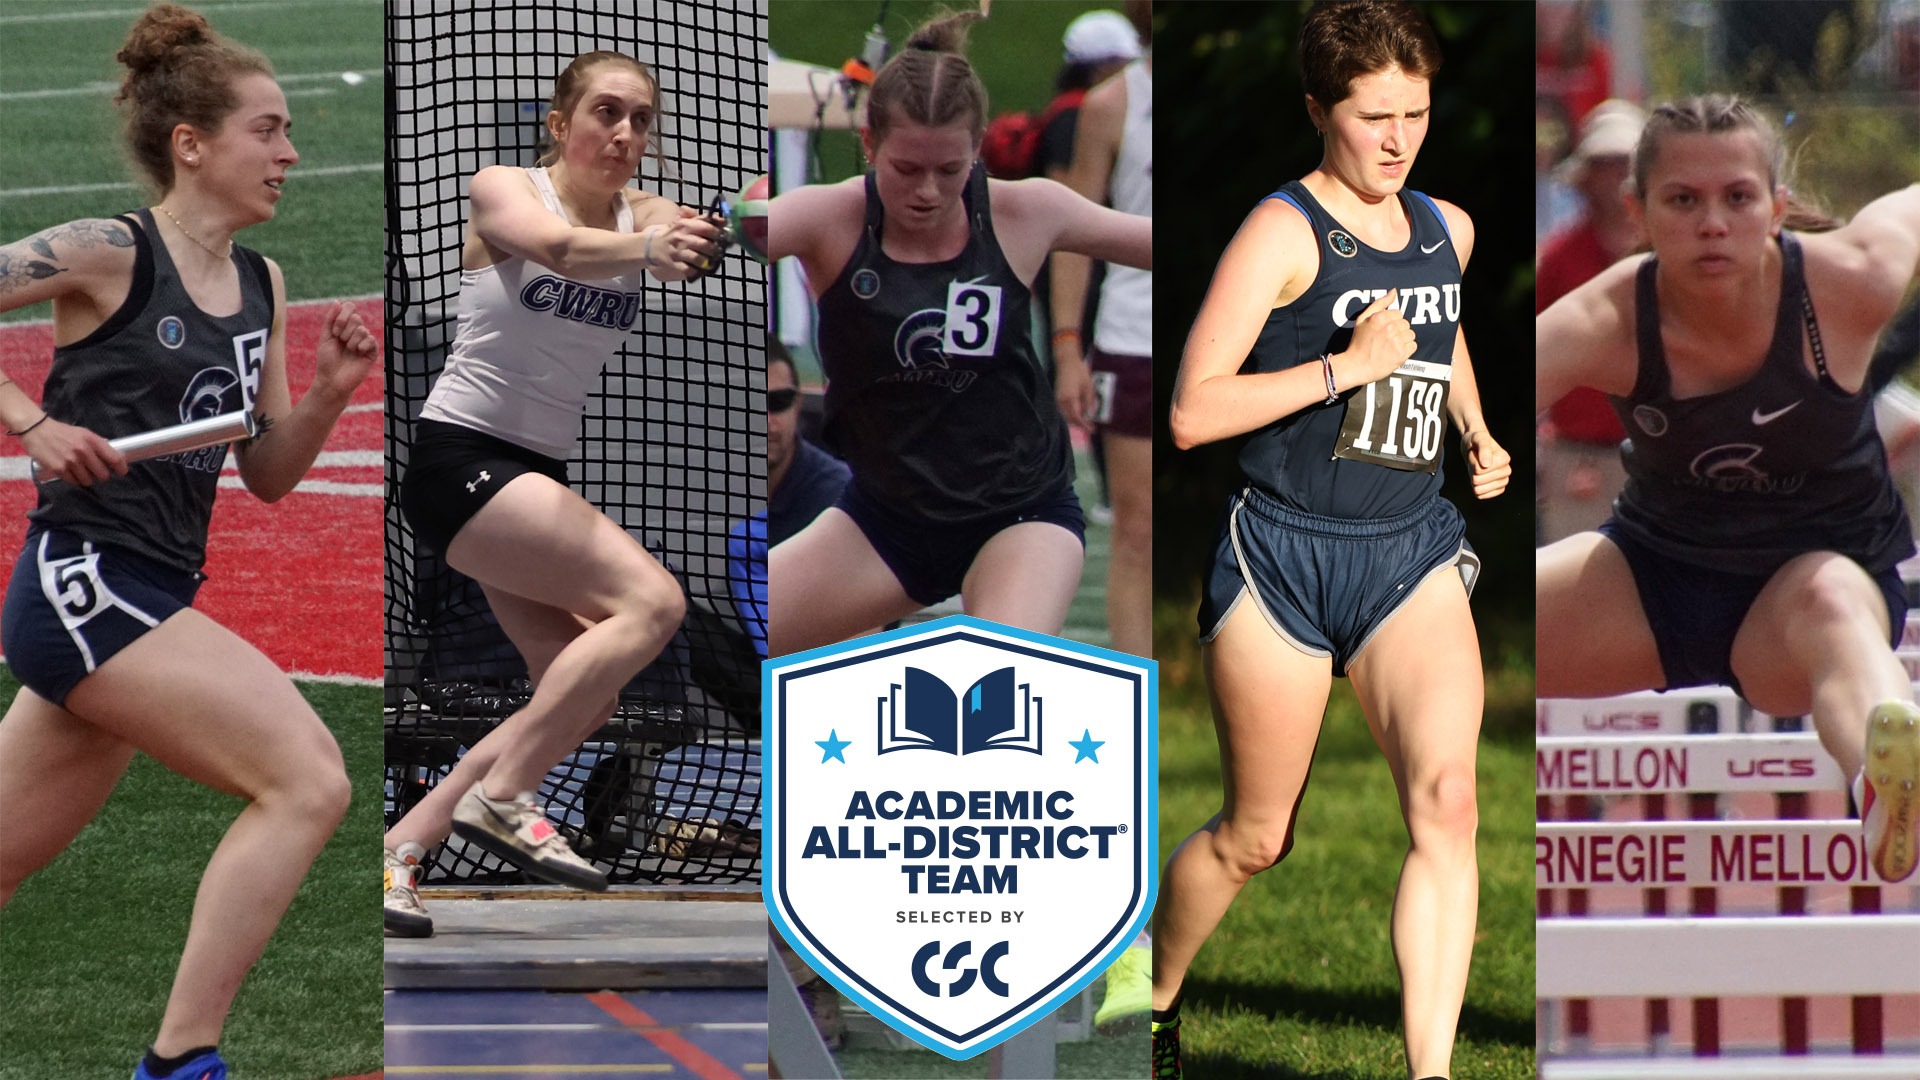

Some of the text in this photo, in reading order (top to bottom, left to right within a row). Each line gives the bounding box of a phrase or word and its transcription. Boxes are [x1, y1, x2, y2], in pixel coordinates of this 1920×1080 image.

[520, 274, 640, 331] CWRU
[951, 288, 990, 351] 3
[241, 336, 262, 404] 5
[1352, 376, 1444, 461] 1158
[54, 557, 97, 617] 5
[1583, 712, 1660, 731] UCS
[1536, 747, 1816, 788] MELLON UCS
[1711, 833, 1868, 882] MELLO
